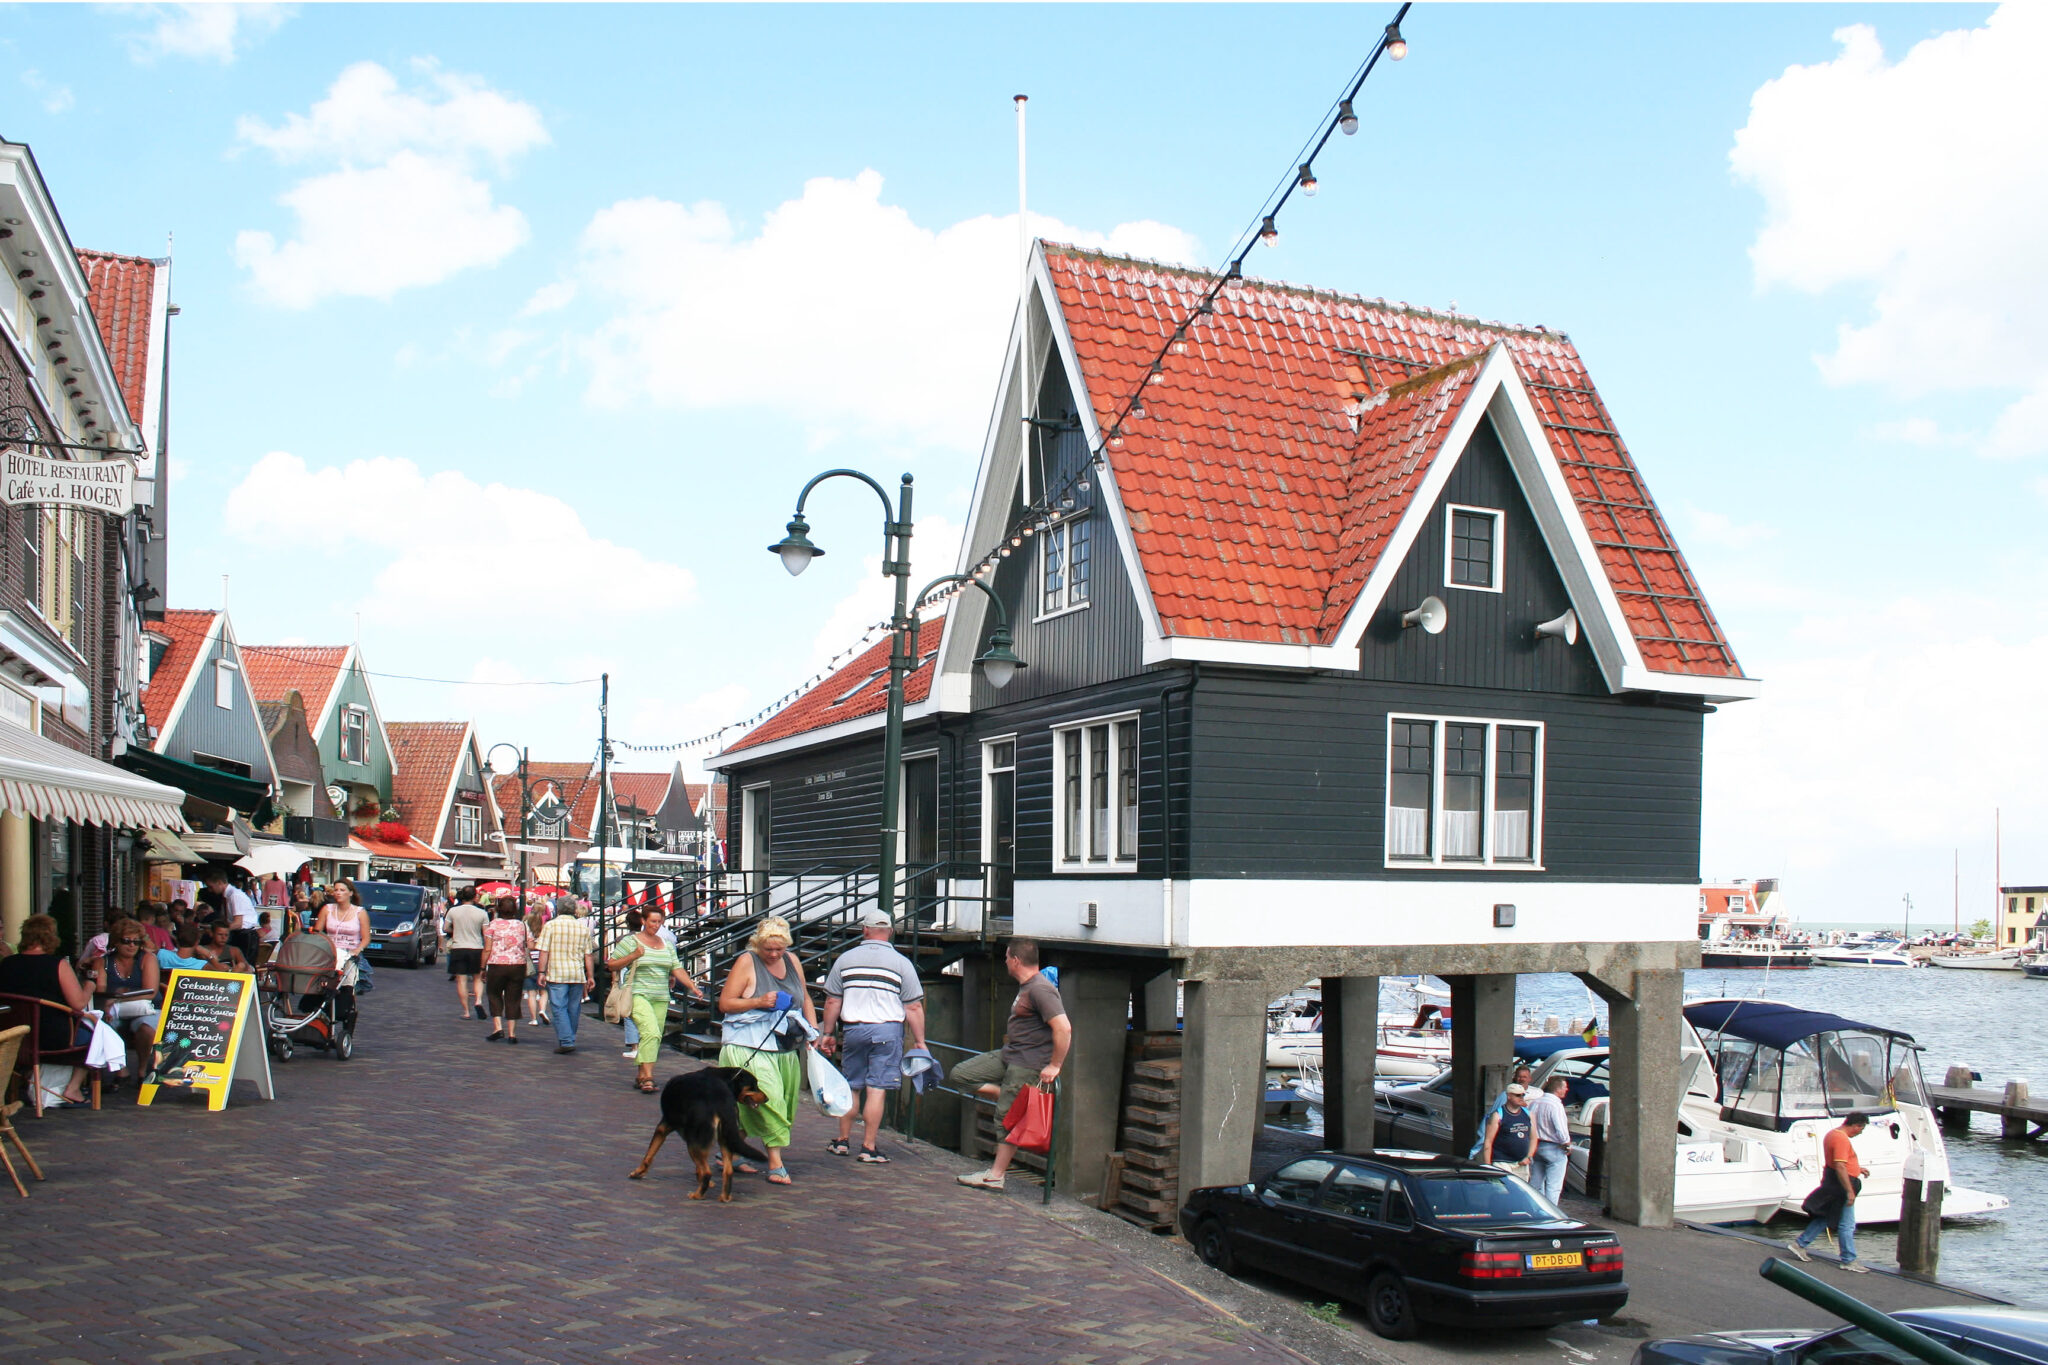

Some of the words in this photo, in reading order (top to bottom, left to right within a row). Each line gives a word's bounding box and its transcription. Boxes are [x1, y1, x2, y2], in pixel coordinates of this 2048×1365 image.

[8, 454, 47, 477] HOTEL
[50, 464, 126, 483] RESTAURANT
[8, 480, 35, 501] Café
[39, 483, 65, 498] v.d.
[70, 484, 123, 508] HOGEN
[178, 977, 226, 992] Gekookte
[183, 991, 230, 1005] Mosselen
[1687, 1151, 1715, 1163] Rebel
[1535, 1254, 1578, 1266] PT-DB-01
